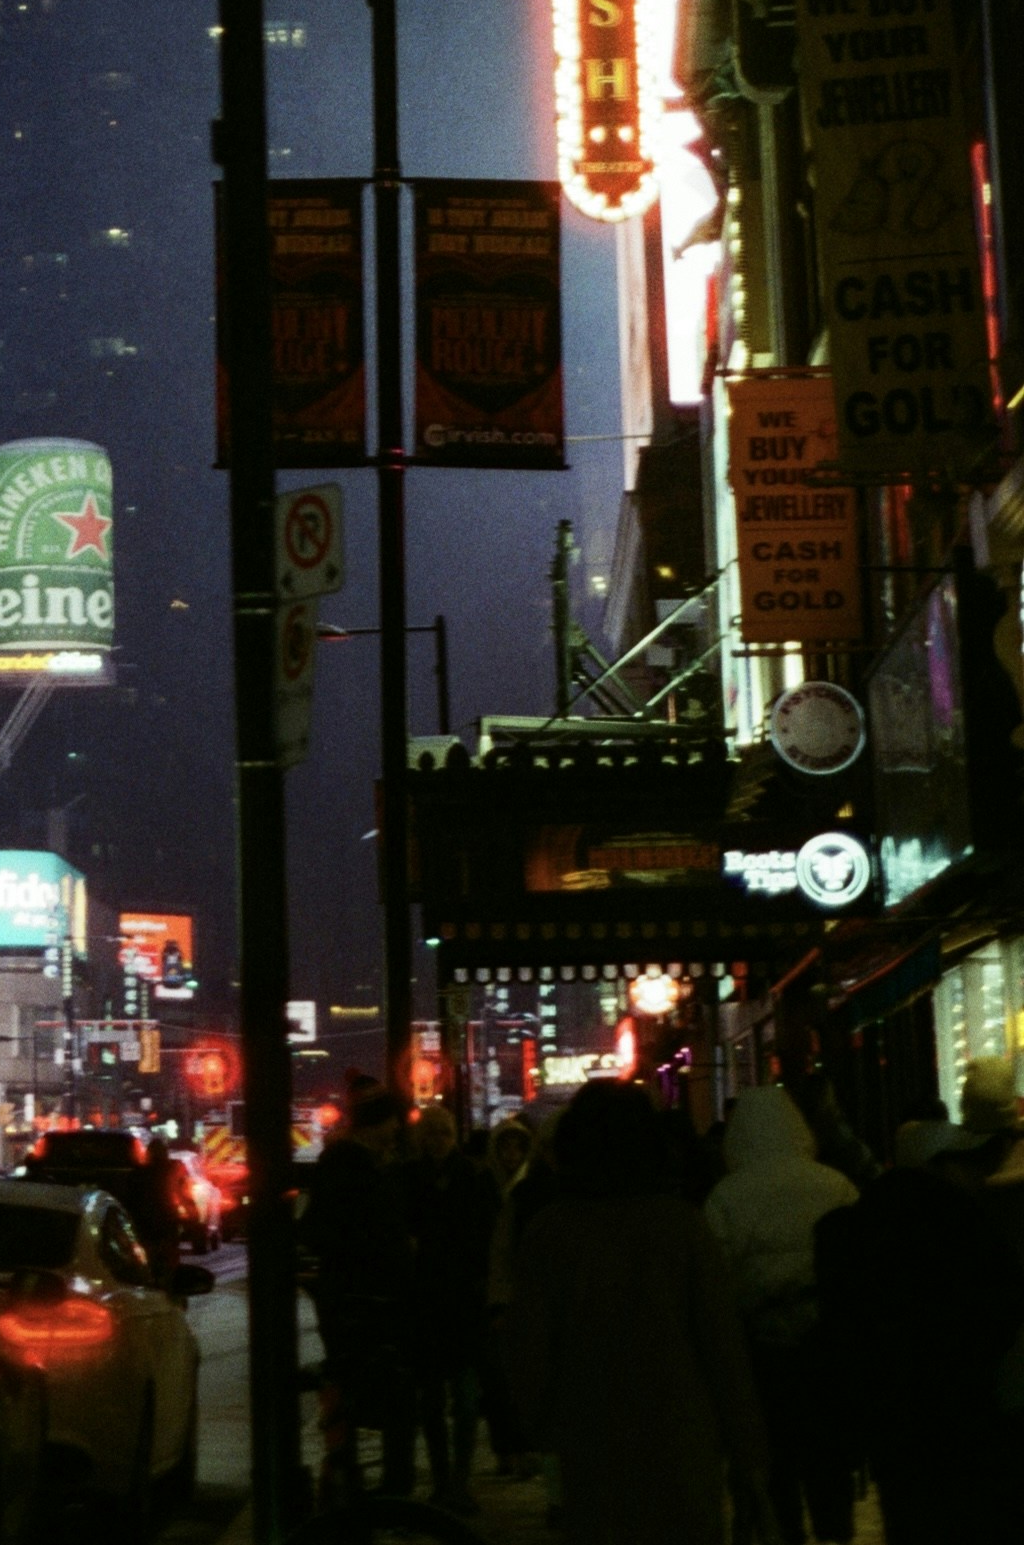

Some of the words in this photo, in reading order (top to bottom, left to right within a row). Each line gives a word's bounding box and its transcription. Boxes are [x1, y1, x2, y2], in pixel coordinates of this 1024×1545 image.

[823, 25, 929, 64] YOUR
[815, 68, 953, 130] JEWELLERY
[834, 271, 973, 321] CASH
[868, 336, 955, 374] FOR
[758, 411, 796, 428] WE
[749, 435, 806, 461] BUY
[742, 493, 847, 522] JEWELLERY
[752, 541, 842, 562] CASH
[774, 568, 819, 584] FOR
[753, 589, 844, 611] GOLD
